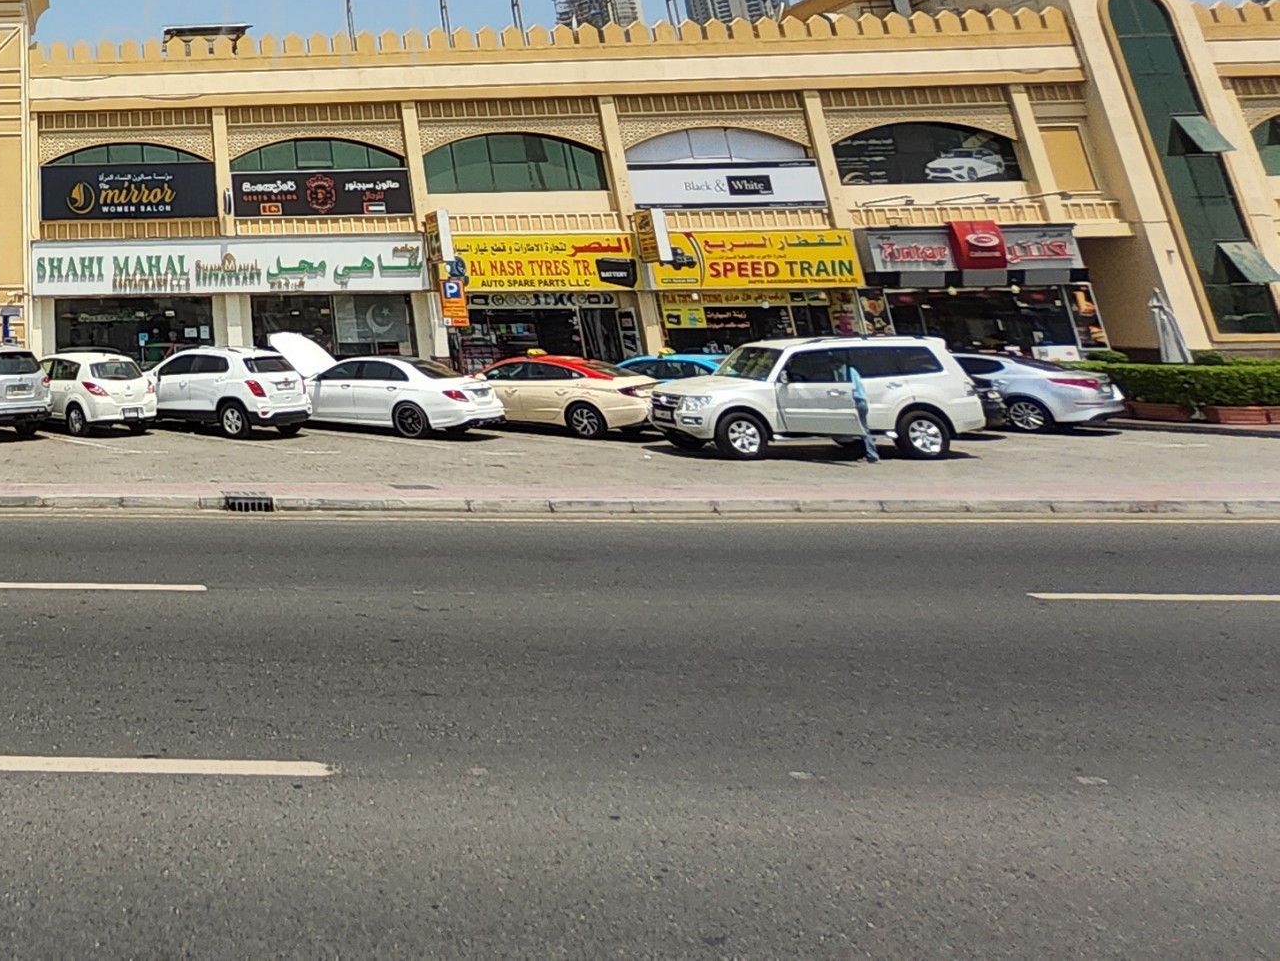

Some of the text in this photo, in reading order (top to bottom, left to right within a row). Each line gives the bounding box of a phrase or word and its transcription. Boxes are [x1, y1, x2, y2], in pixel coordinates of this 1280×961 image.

[99, 181, 177, 205] mirror
[683, 181, 712, 191] Black
[731, 180, 765, 190] White
[567, 236, 631, 258] النصر
[36, 254, 191, 280] SHAHI MAHAL
[469, 260, 485, 276] AL
[489, 260, 525, 276] NASR
[528, 259, 571, 276] TYRES
[708, 259, 855, 279] SPEED TRAIN
[445, 282, 459, 299] P
[481, 279, 505, 287] AUTO
[507, 279, 536, 287] SPARE
[538, 279, 567, 287] PARTS
